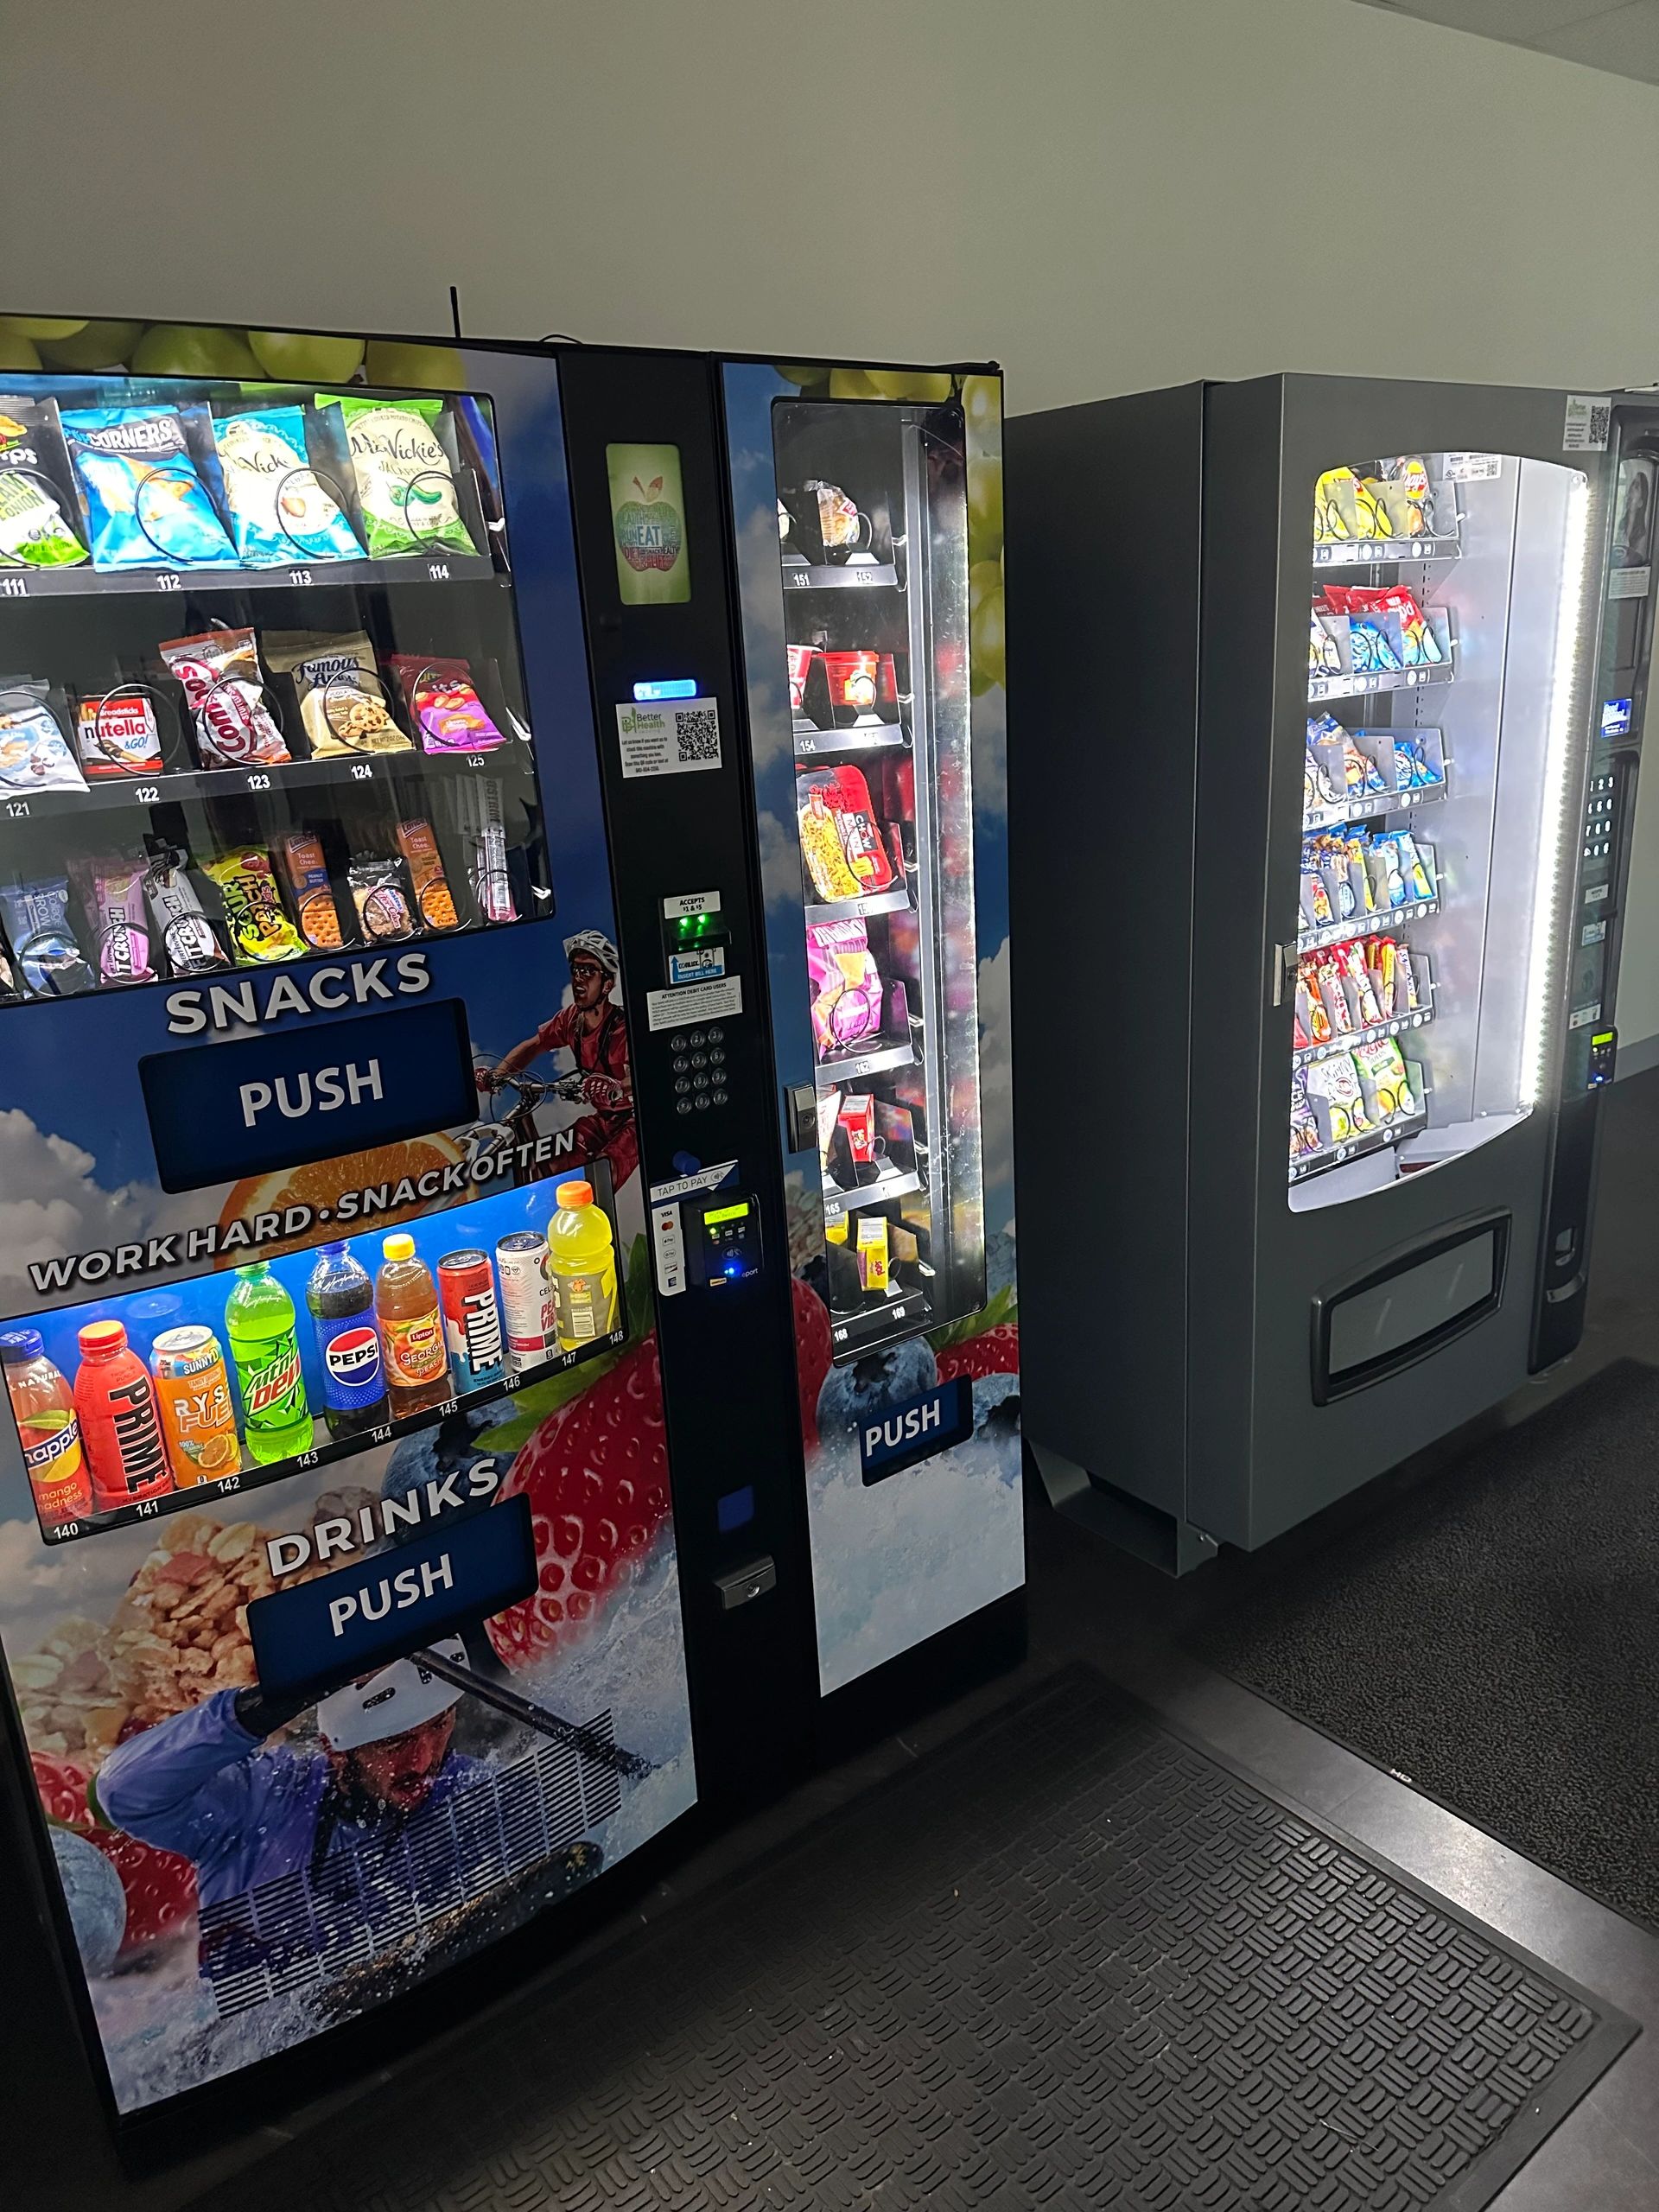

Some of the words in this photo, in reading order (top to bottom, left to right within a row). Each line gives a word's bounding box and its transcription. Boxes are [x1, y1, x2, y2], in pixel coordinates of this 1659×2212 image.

[388, 429, 444, 466] Vickie's
[4, 489, 45, 518] ONION
[637, 525, 660, 546] EAT
[289, 571, 312, 584] 113
[430, 565, 450, 579] 114
[793, 574, 810, 586] 151
[3, 578, 27, 595] 111
[157, 575, 181, 590] 112
[291, 657, 359, 684] Famous
[637, 713, 662, 722] Better
[638, 720, 665, 729] Health
[85, 719, 146, 739] nutella
[800, 739, 816, 752] 154
[467, 754, 485, 767] 125
[351, 765, 372, 779] 124
[248, 775, 270, 790] 123
[136, 787, 160, 803] 122
[6, 801, 30, 817] 121
[855, 815, 872, 849] CHOW
[679, 897, 705, 906] ACCEPTS
[223, 882, 259, 940] SOUR
[166, 953, 430, 1034] SNACKS
[662, 990, 686, 999] ATTENTION
[238, 1058, 383, 1128] PUSH
[658, 1185, 675, 1197] TAP
[677, 1180, 688, 1192] TO
[690, 1176, 708, 1188] PAY
[29, 1236, 179, 1292] WORK
[188, 1204, 312, 1261] HARD
[336, 1160, 466, 1220] SNACK
[471, 1129, 575, 1181] OFTEN
[825, 1203, 840, 1215] 165
[892, 1306, 906, 1319] 169
[461, 1287, 503, 1372] PRIME
[540, 1313, 556, 1332] VIB
[412, 1329, 433, 1340] Lipton
[609, 1331, 624, 1344] 148
[834, 1328, 848, 1341] 168
[329, 1343, 378, 1366] PEPSI
[562, 1351, 576, 1365] 147
[503, 1376, 520, 1391] 146
[175, 1382, 230, 1416] RYS
[439, 1401, 458, 1416] 145
[108, 1375, 168, 1495] PRIME
[372, 1427, 391, 1442] 144
[866, 1399, 940, 1457] PUSH
[25, 1421, 78, 1464] napple
[297, 1452, 319, 1468] 143
[39, 1482, 78, 1500] mango
[218, 1477, 240, 1493] 142
[137, 1500, 158, 1517] 141
[267, 1458, 499, 1577] DRINKS
[54, 1522, 79, 1540] 140
[329, 1554, 454, 1637] PUSH
